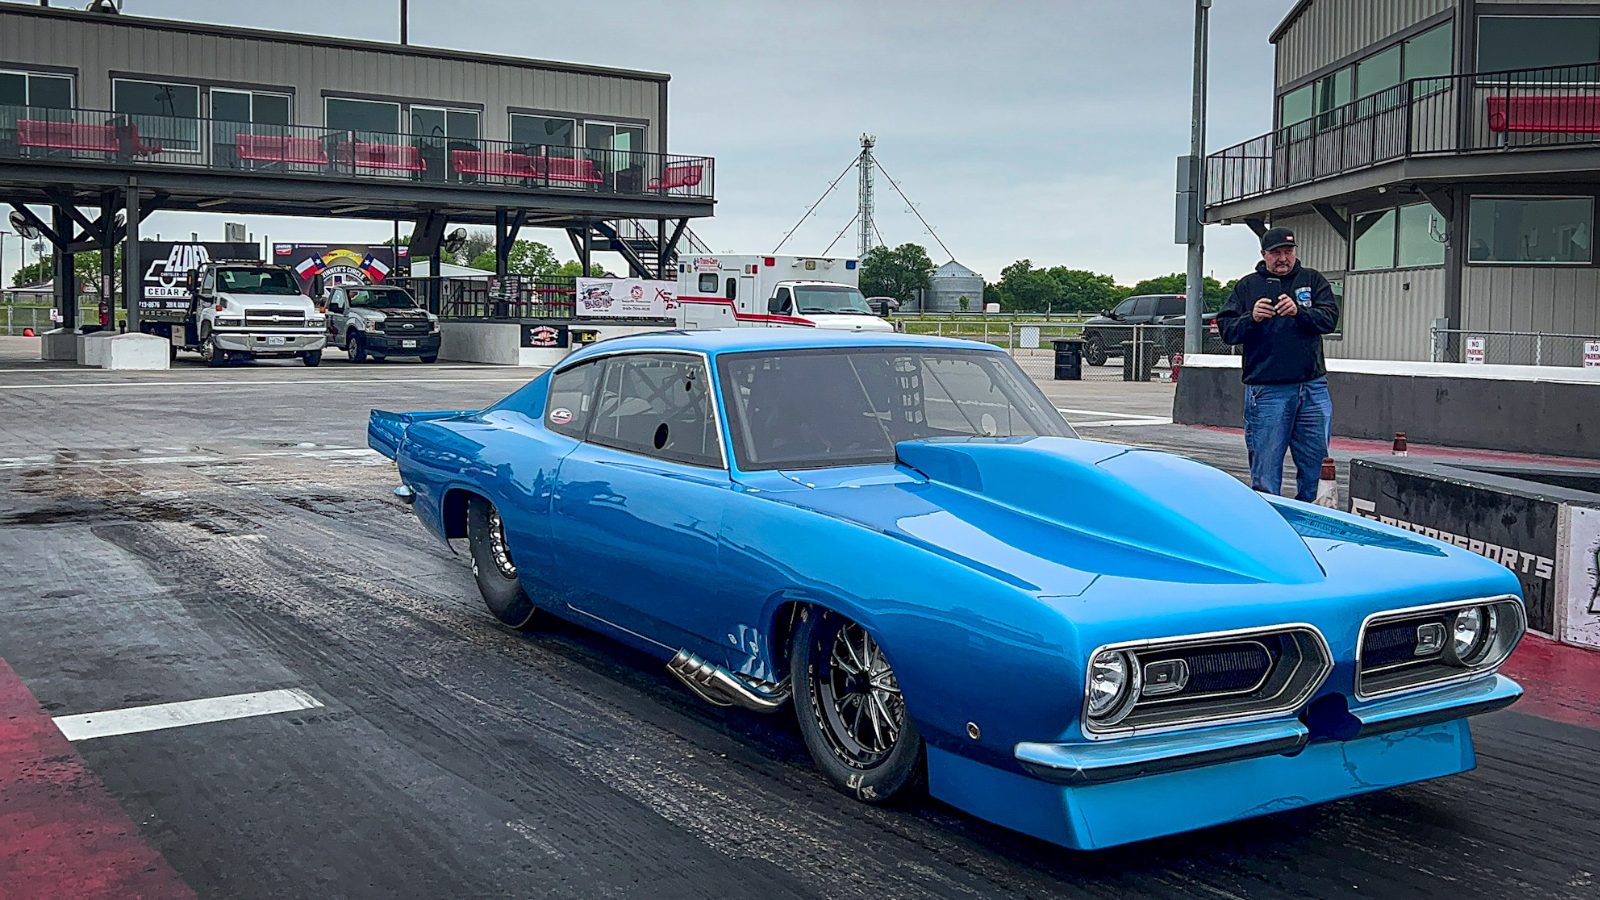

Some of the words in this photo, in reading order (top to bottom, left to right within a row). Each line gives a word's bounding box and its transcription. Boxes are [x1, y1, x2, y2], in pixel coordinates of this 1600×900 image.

[347, 267, 366, 280] CIRCLE
[148, 288, 179, 296] CEDAR
[1590, 344, 1599, 352] NO
[833, 747, 864, 770] WELD
